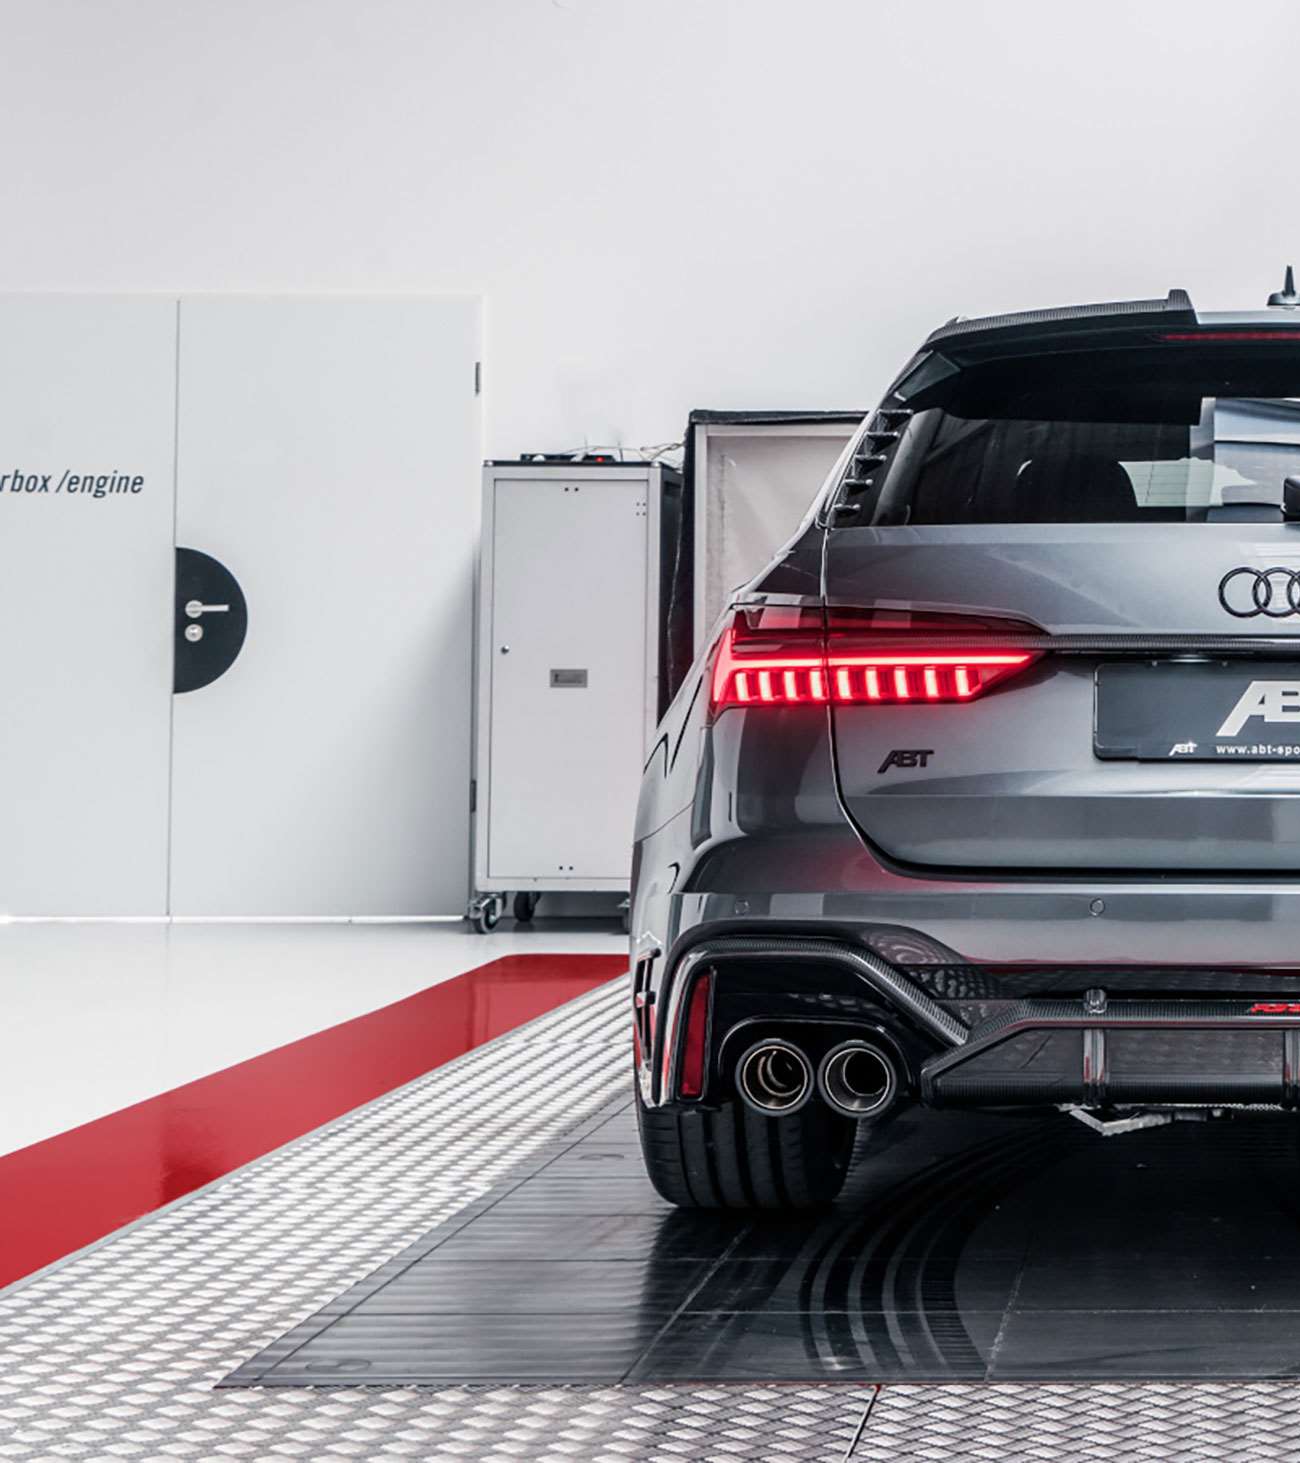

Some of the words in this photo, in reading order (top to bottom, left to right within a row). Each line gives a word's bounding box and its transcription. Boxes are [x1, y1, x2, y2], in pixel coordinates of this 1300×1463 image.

[55, 469, 145, 499] /engine
[877, 749, 935, 774] ABT
[1168, 742, 1198, 757] ABT
